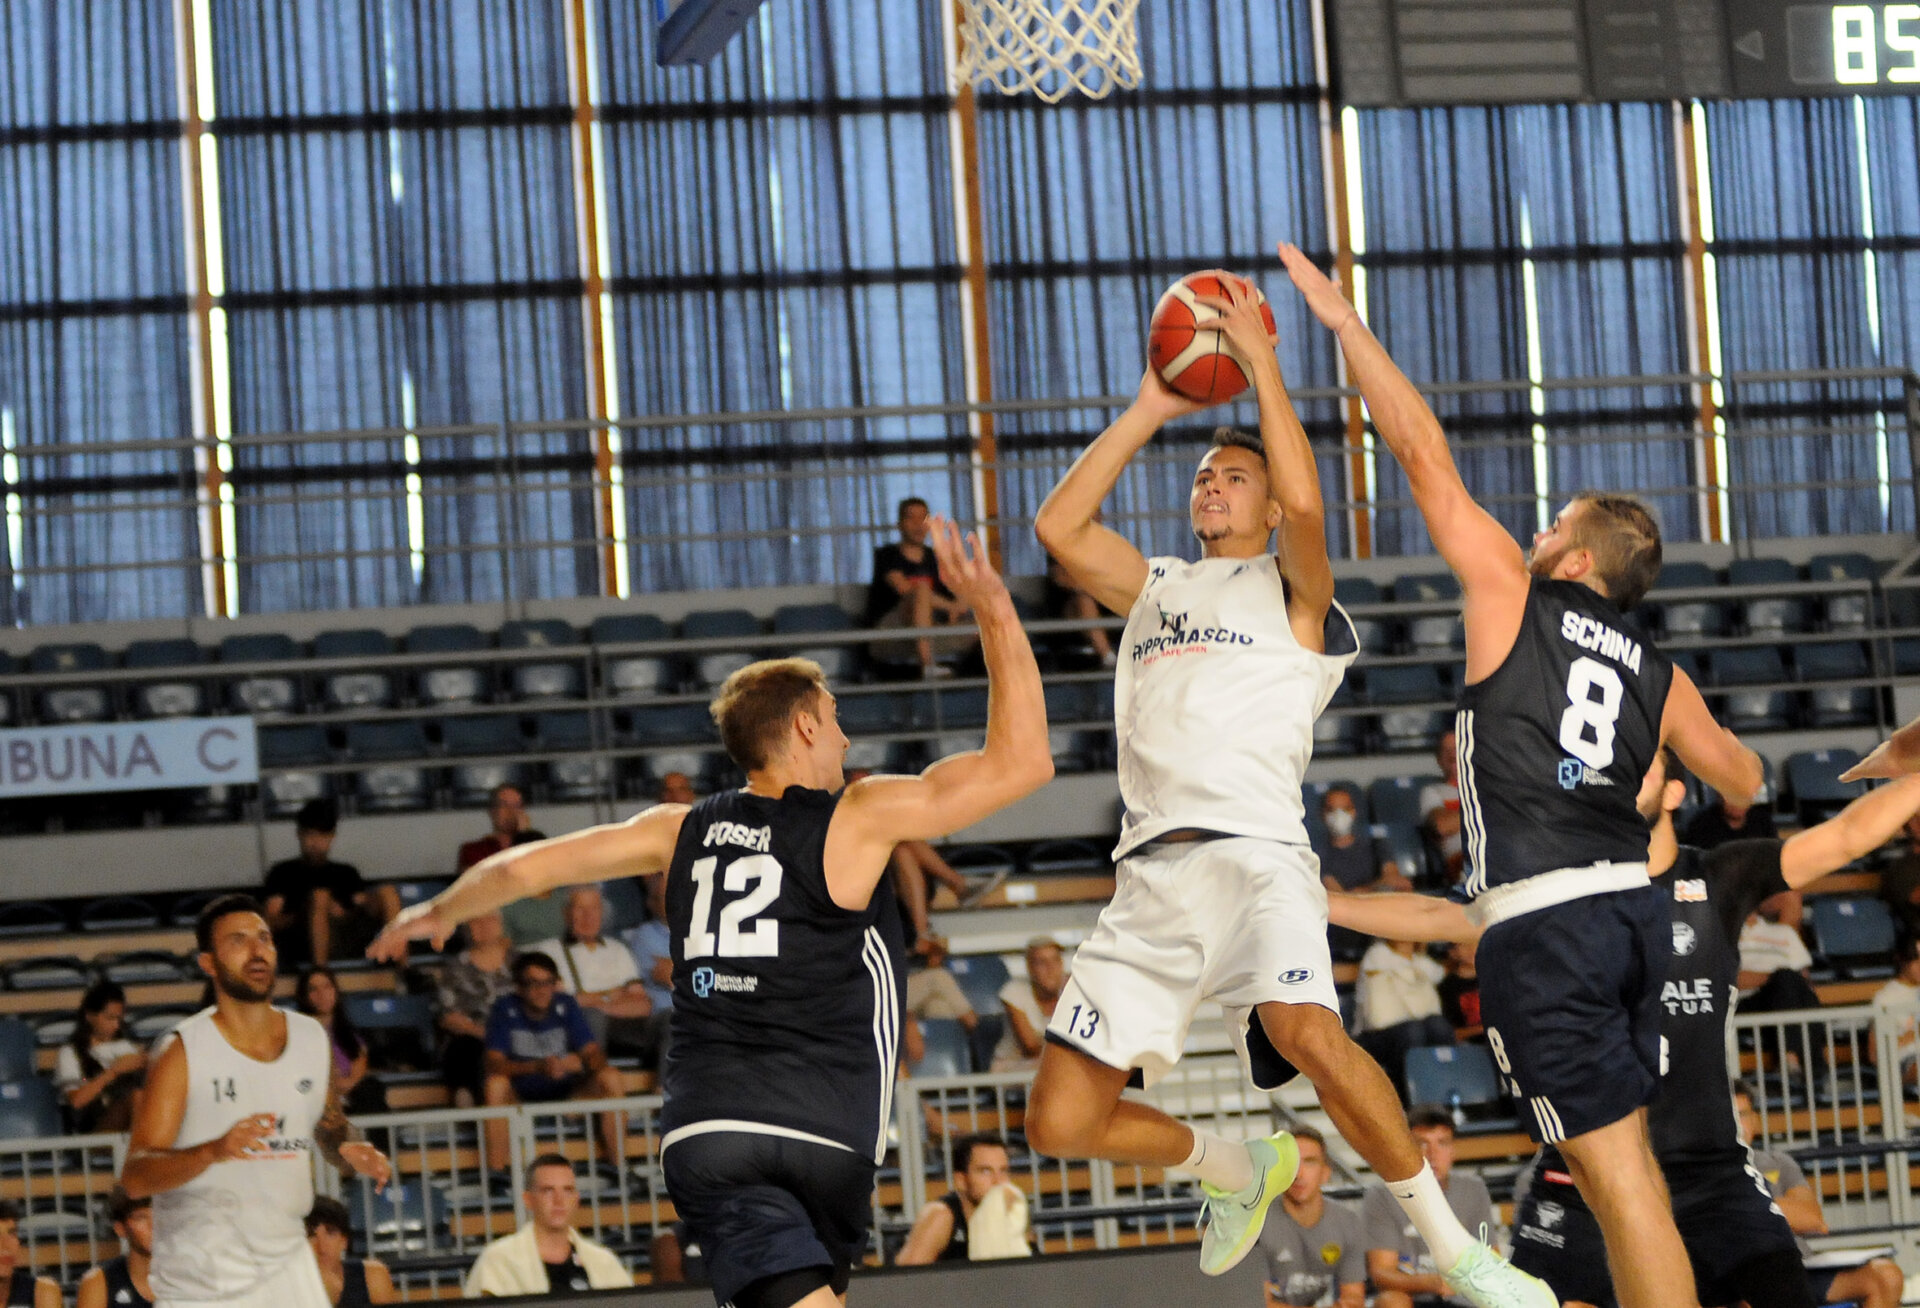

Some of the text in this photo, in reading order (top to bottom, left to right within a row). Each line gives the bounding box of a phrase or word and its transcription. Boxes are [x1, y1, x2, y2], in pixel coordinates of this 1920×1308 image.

[1832, 4, 1920, 85] 85
[1561, 610, 1642, 676] SCHINA
[1559, 655, 1624, 771] 8
[197, 727, 239, 773] C
[683, 854, 783, 961] 12
[1067, 1003, 1100, 1040] 13
[211, 1077, 237, 1104] 14
